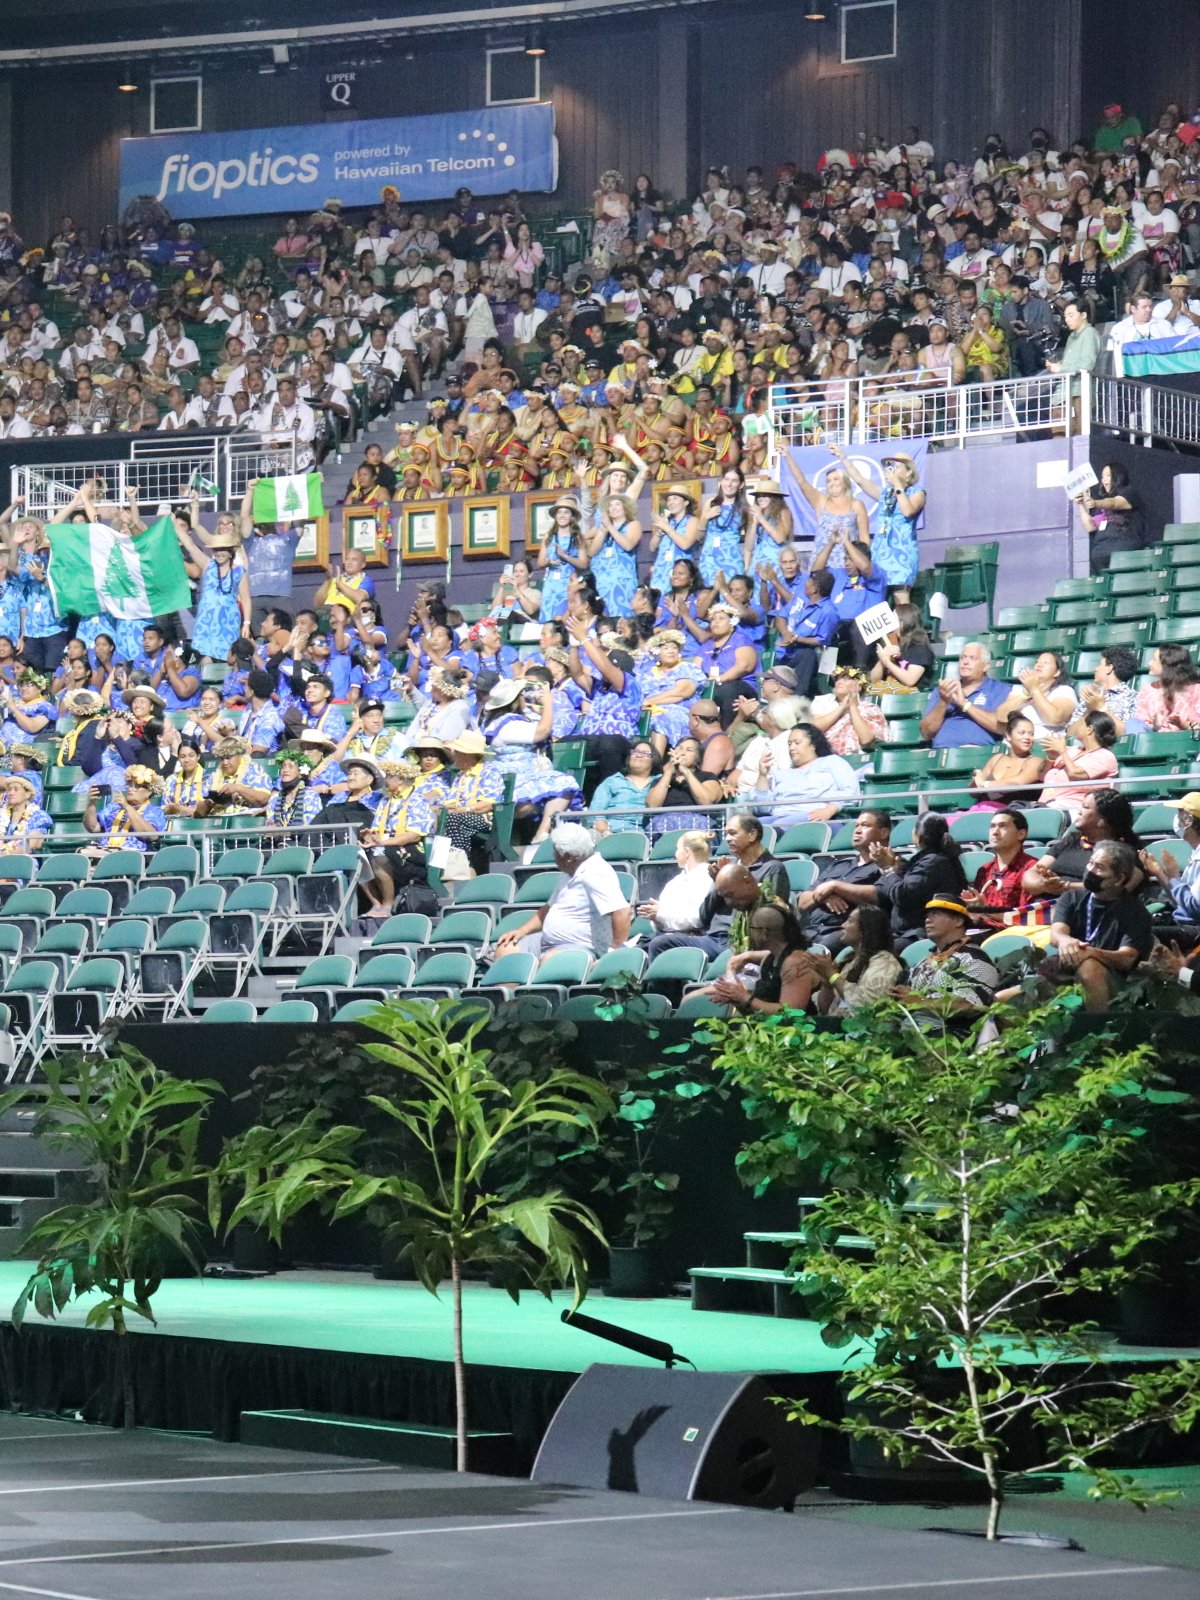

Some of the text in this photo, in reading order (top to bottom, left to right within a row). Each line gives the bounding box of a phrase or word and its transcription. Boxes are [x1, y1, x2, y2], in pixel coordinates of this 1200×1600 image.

[326, 73, 356, 82] UPPER
[331, 82, 350, 105] Q
[334, 143, 411, 162] powered by
[156, 147, 321, 202] fioptics
[334, 156, 495, 180] Hawaiian Telcom
[861, 612, 892, 637] NIUE
